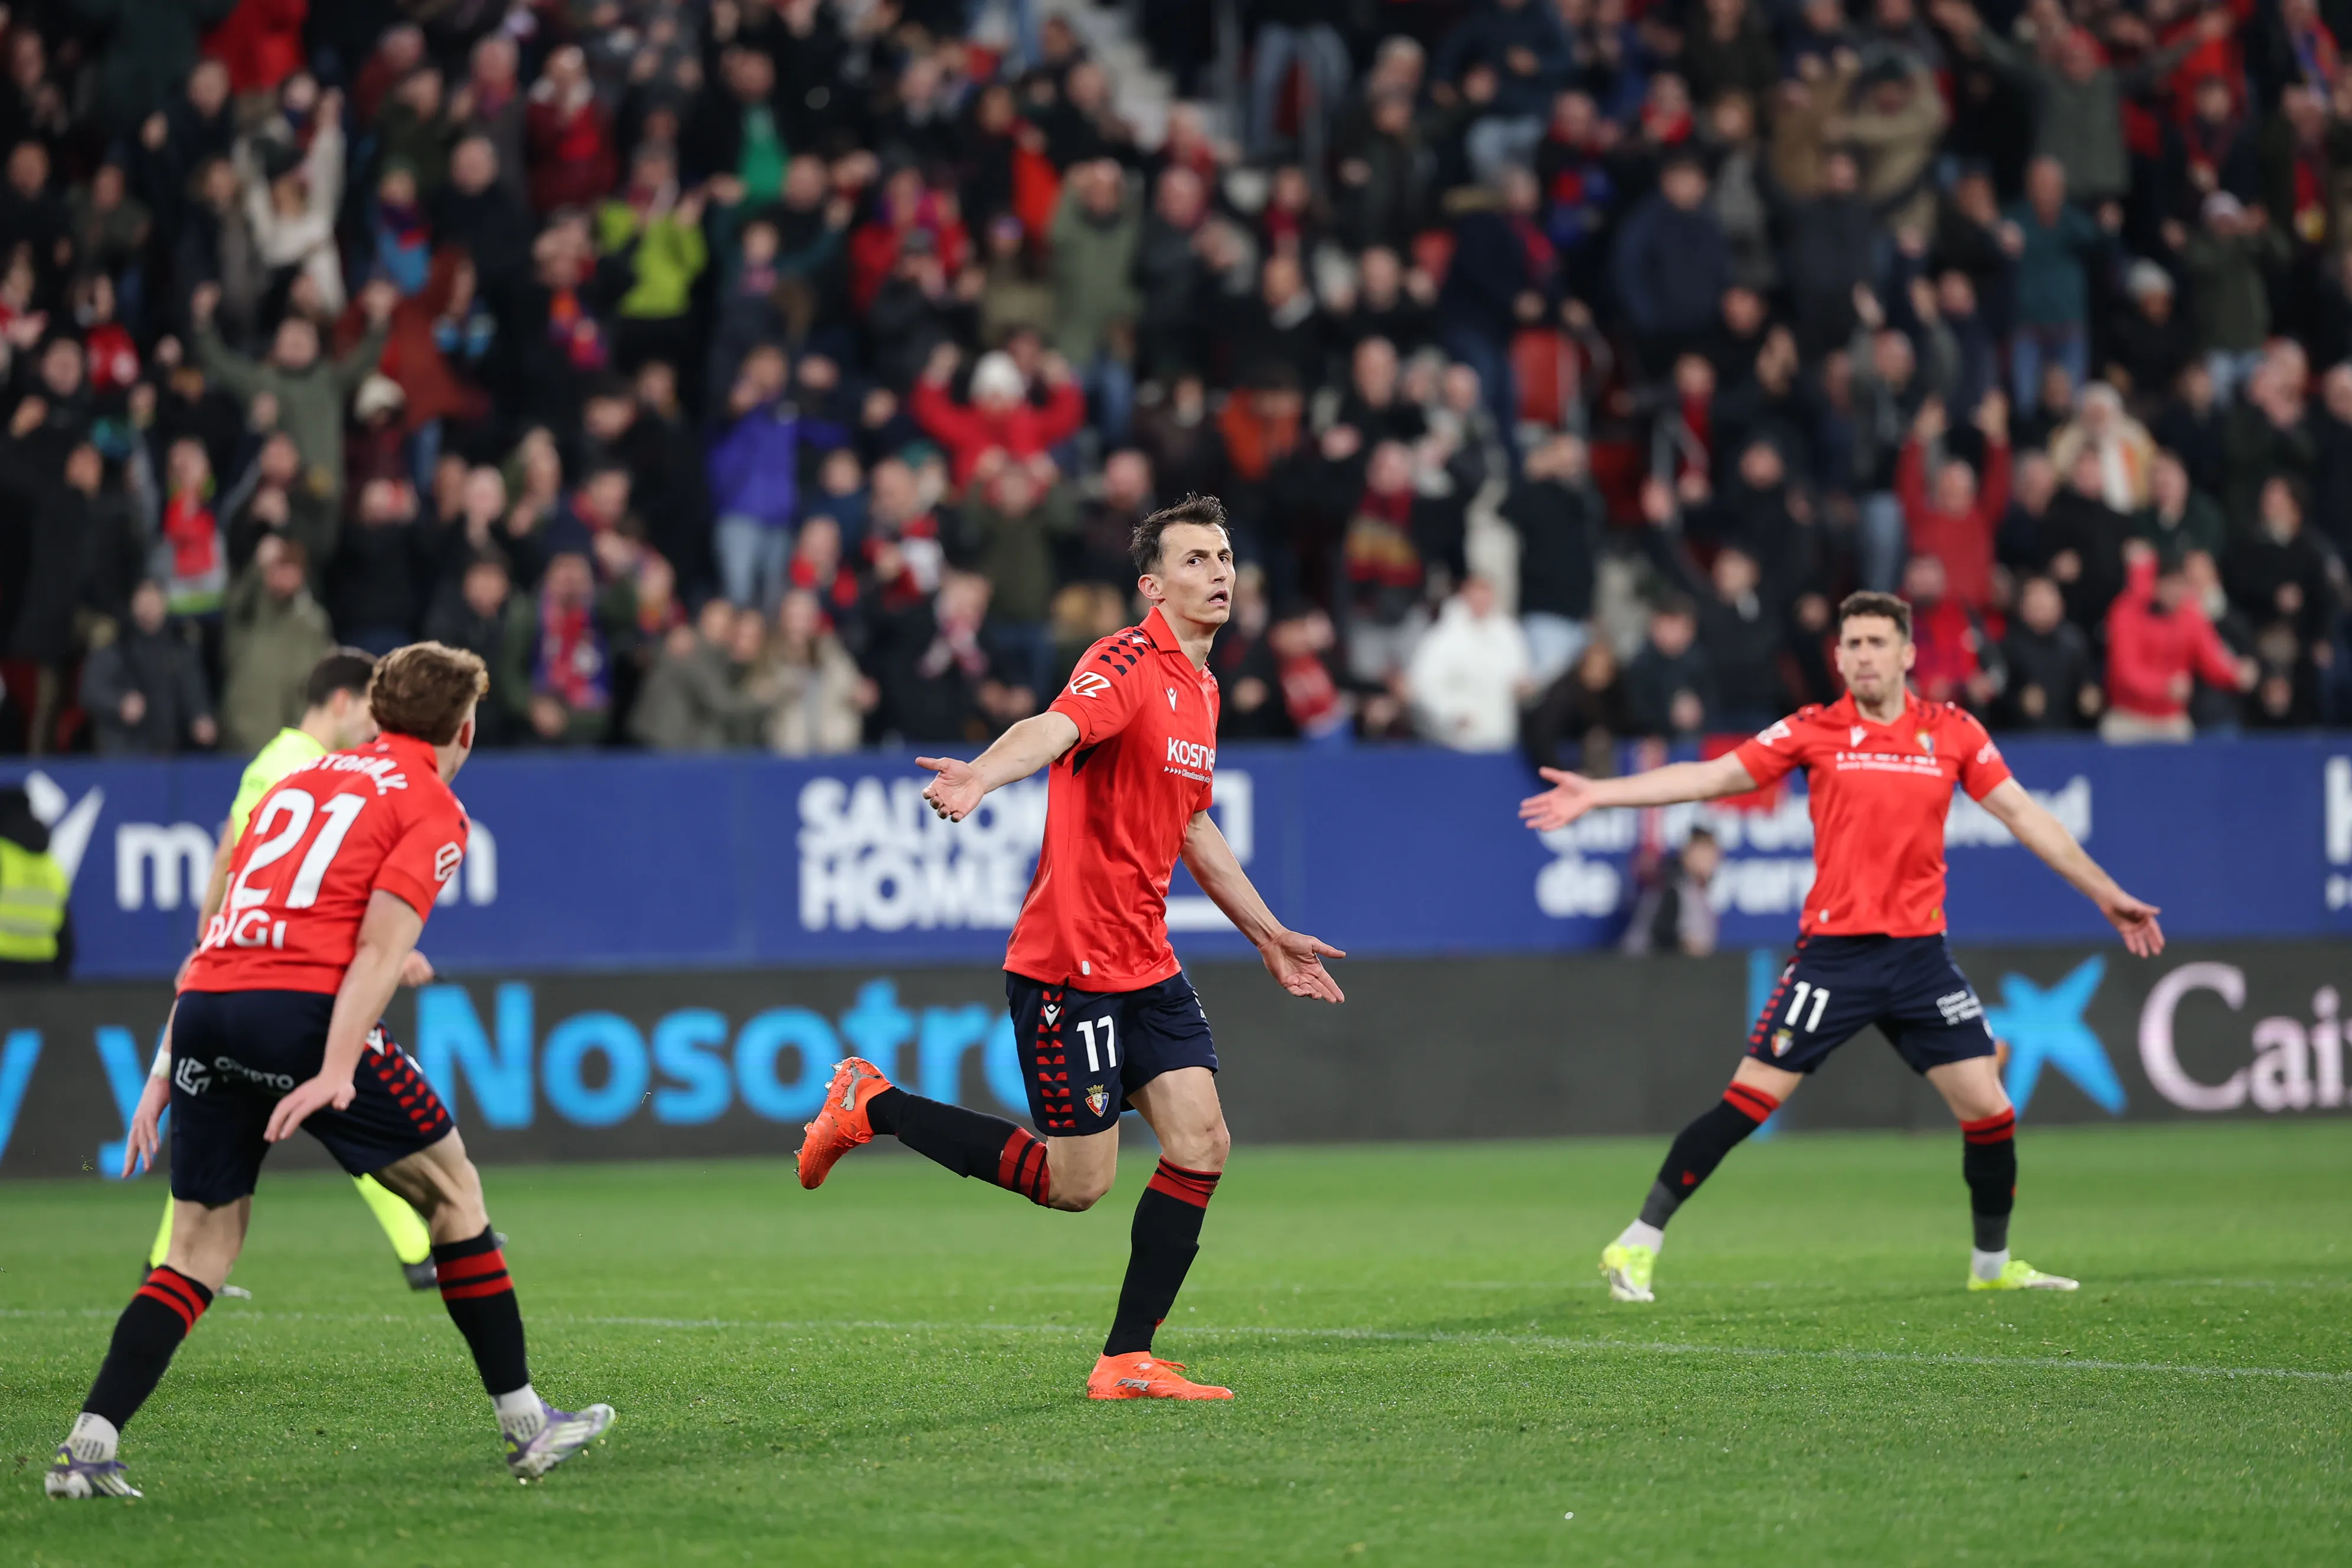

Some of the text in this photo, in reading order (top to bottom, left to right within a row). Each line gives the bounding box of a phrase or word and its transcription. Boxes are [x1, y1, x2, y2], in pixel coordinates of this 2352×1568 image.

[230, 788, 368, 910] 21
[198, 908, 288, 955] DIGI
[1785, 981, 1830, 1033] 11
[1076, 1015, 1117, 1072] 17
[2138, 962, 2352, 1112] Cai
